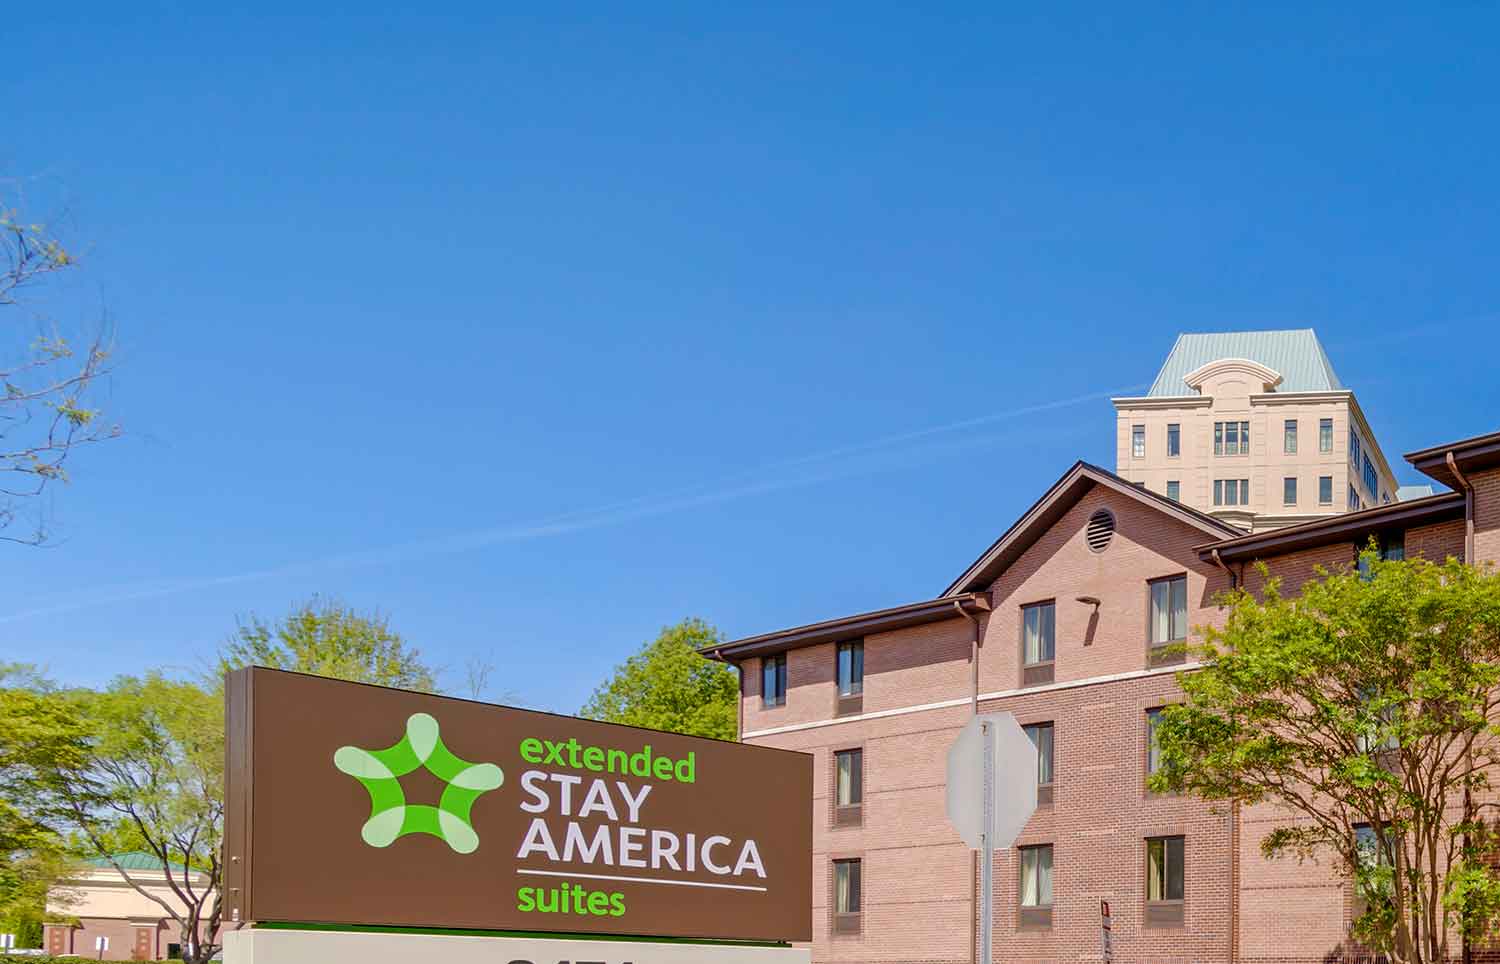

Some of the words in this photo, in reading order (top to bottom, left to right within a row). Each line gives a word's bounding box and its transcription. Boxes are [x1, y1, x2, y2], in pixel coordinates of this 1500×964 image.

[519, 737, 696, 784] extended
[519, 770, 653, 824] STAY
[516, 818, 768, 879] AMERICA
[517, 882, 626, 917] suites
